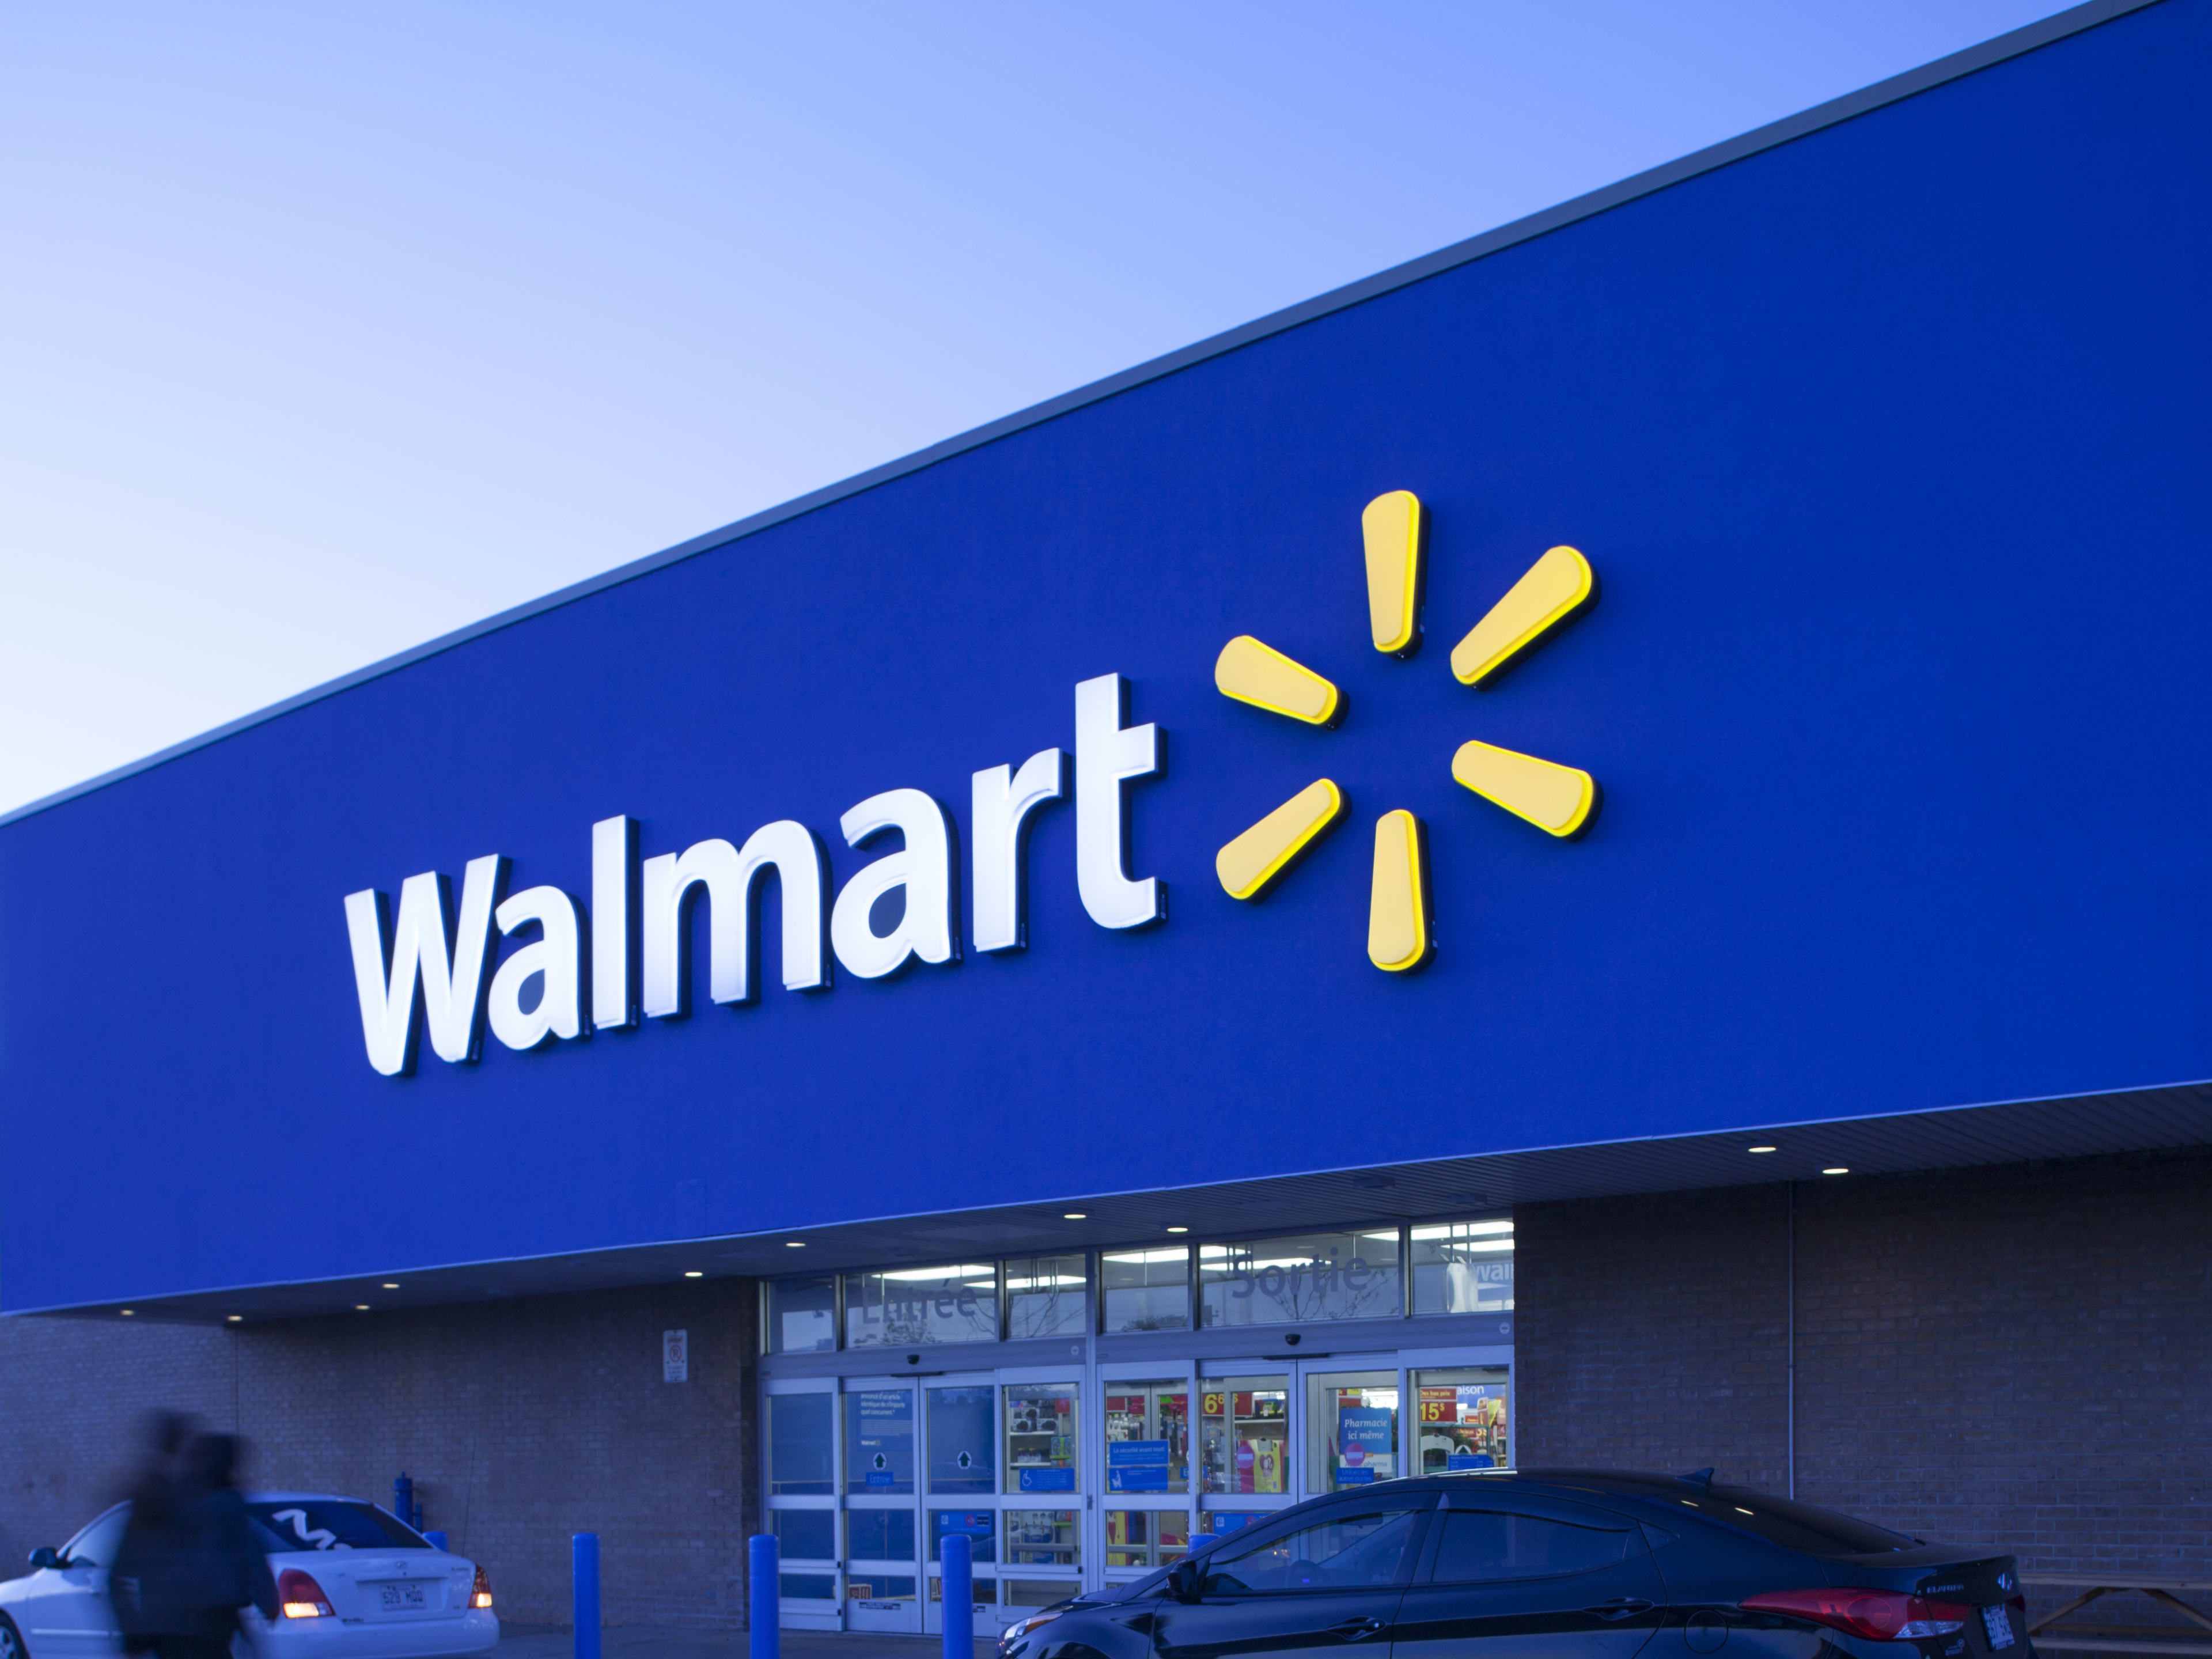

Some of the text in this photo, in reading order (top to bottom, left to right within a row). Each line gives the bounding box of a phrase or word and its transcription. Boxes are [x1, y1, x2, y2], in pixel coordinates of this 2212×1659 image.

[344, 672, 1164, 1076] Walmart
[1232, 1247, 1369, 1299] Sortie
[863, 1278, 976, 1323] Entrée
[1440, 1389, 1450, 1398] prix
[1457, 1385, 1484, 1395] aison
[1344, 1418, 1388, 1428] Pharmacie
[1348, 1430, 1384, 1440] ici même
[383, 1590, 401, 1604] 529
